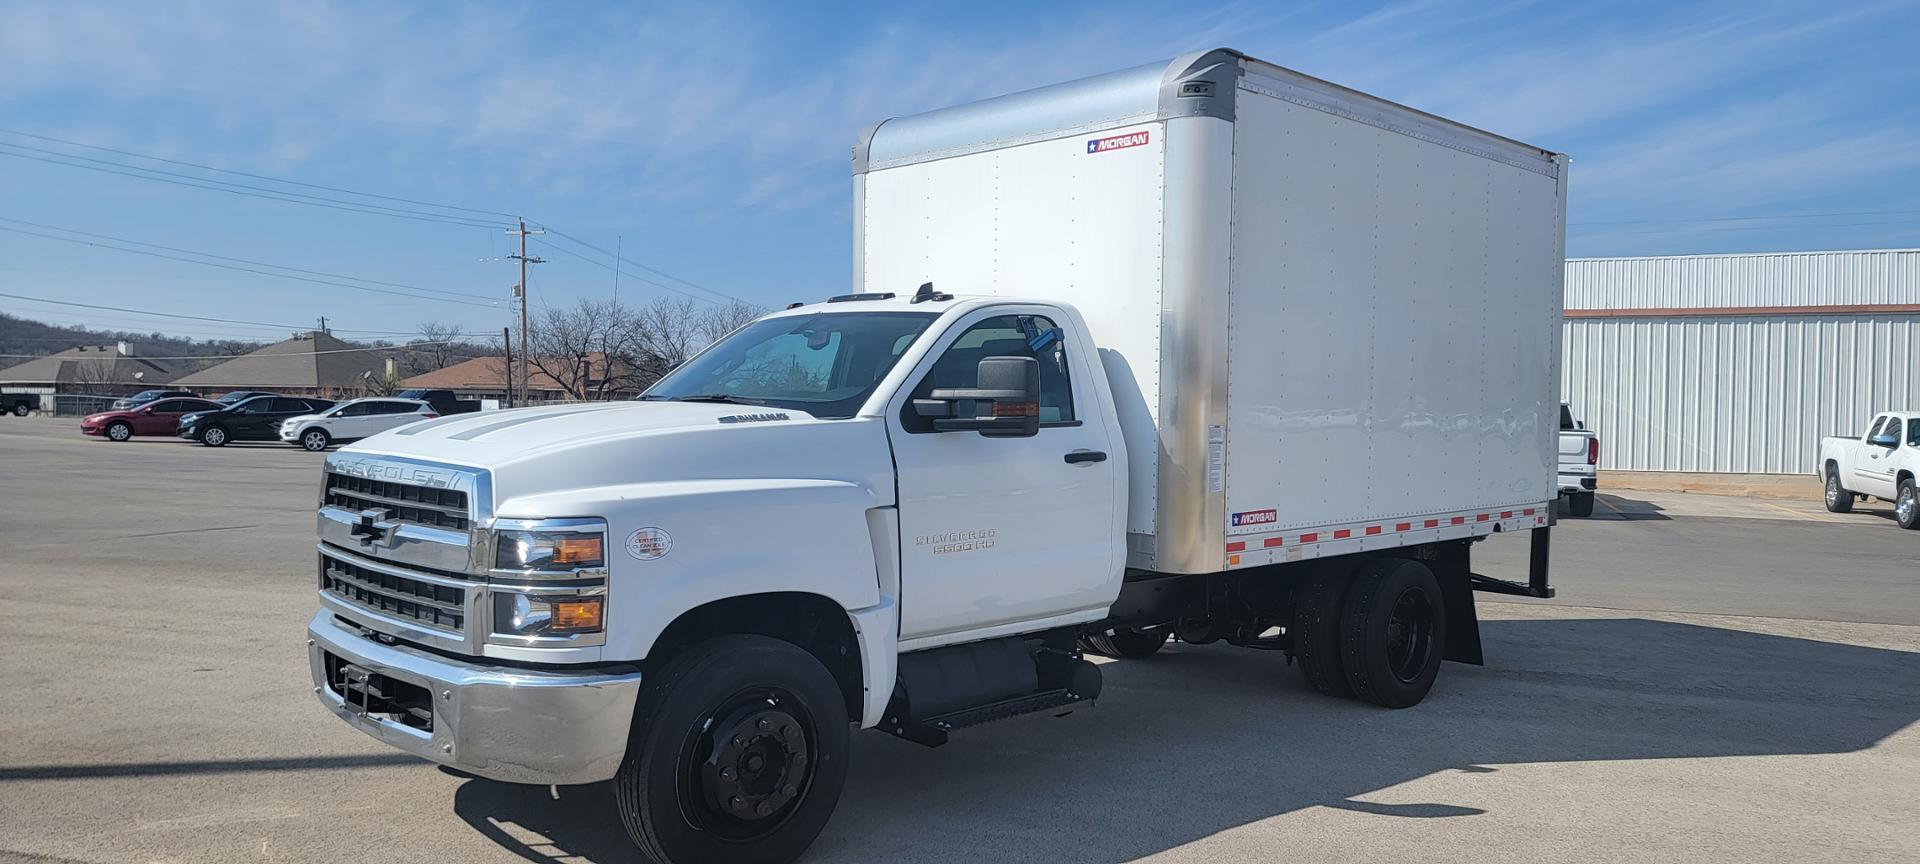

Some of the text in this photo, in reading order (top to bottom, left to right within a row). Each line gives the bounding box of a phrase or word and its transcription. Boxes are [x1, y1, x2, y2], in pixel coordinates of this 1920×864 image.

[1098, 133, 1148, 151] MORGAN
[336, 459, 446, 485] CHEVROLET
[1241, 511, 1276, 524] MORGAN
[916, 529, 997, 546] SILVERADO
[933, 539, 995, 554] 5500 HD
